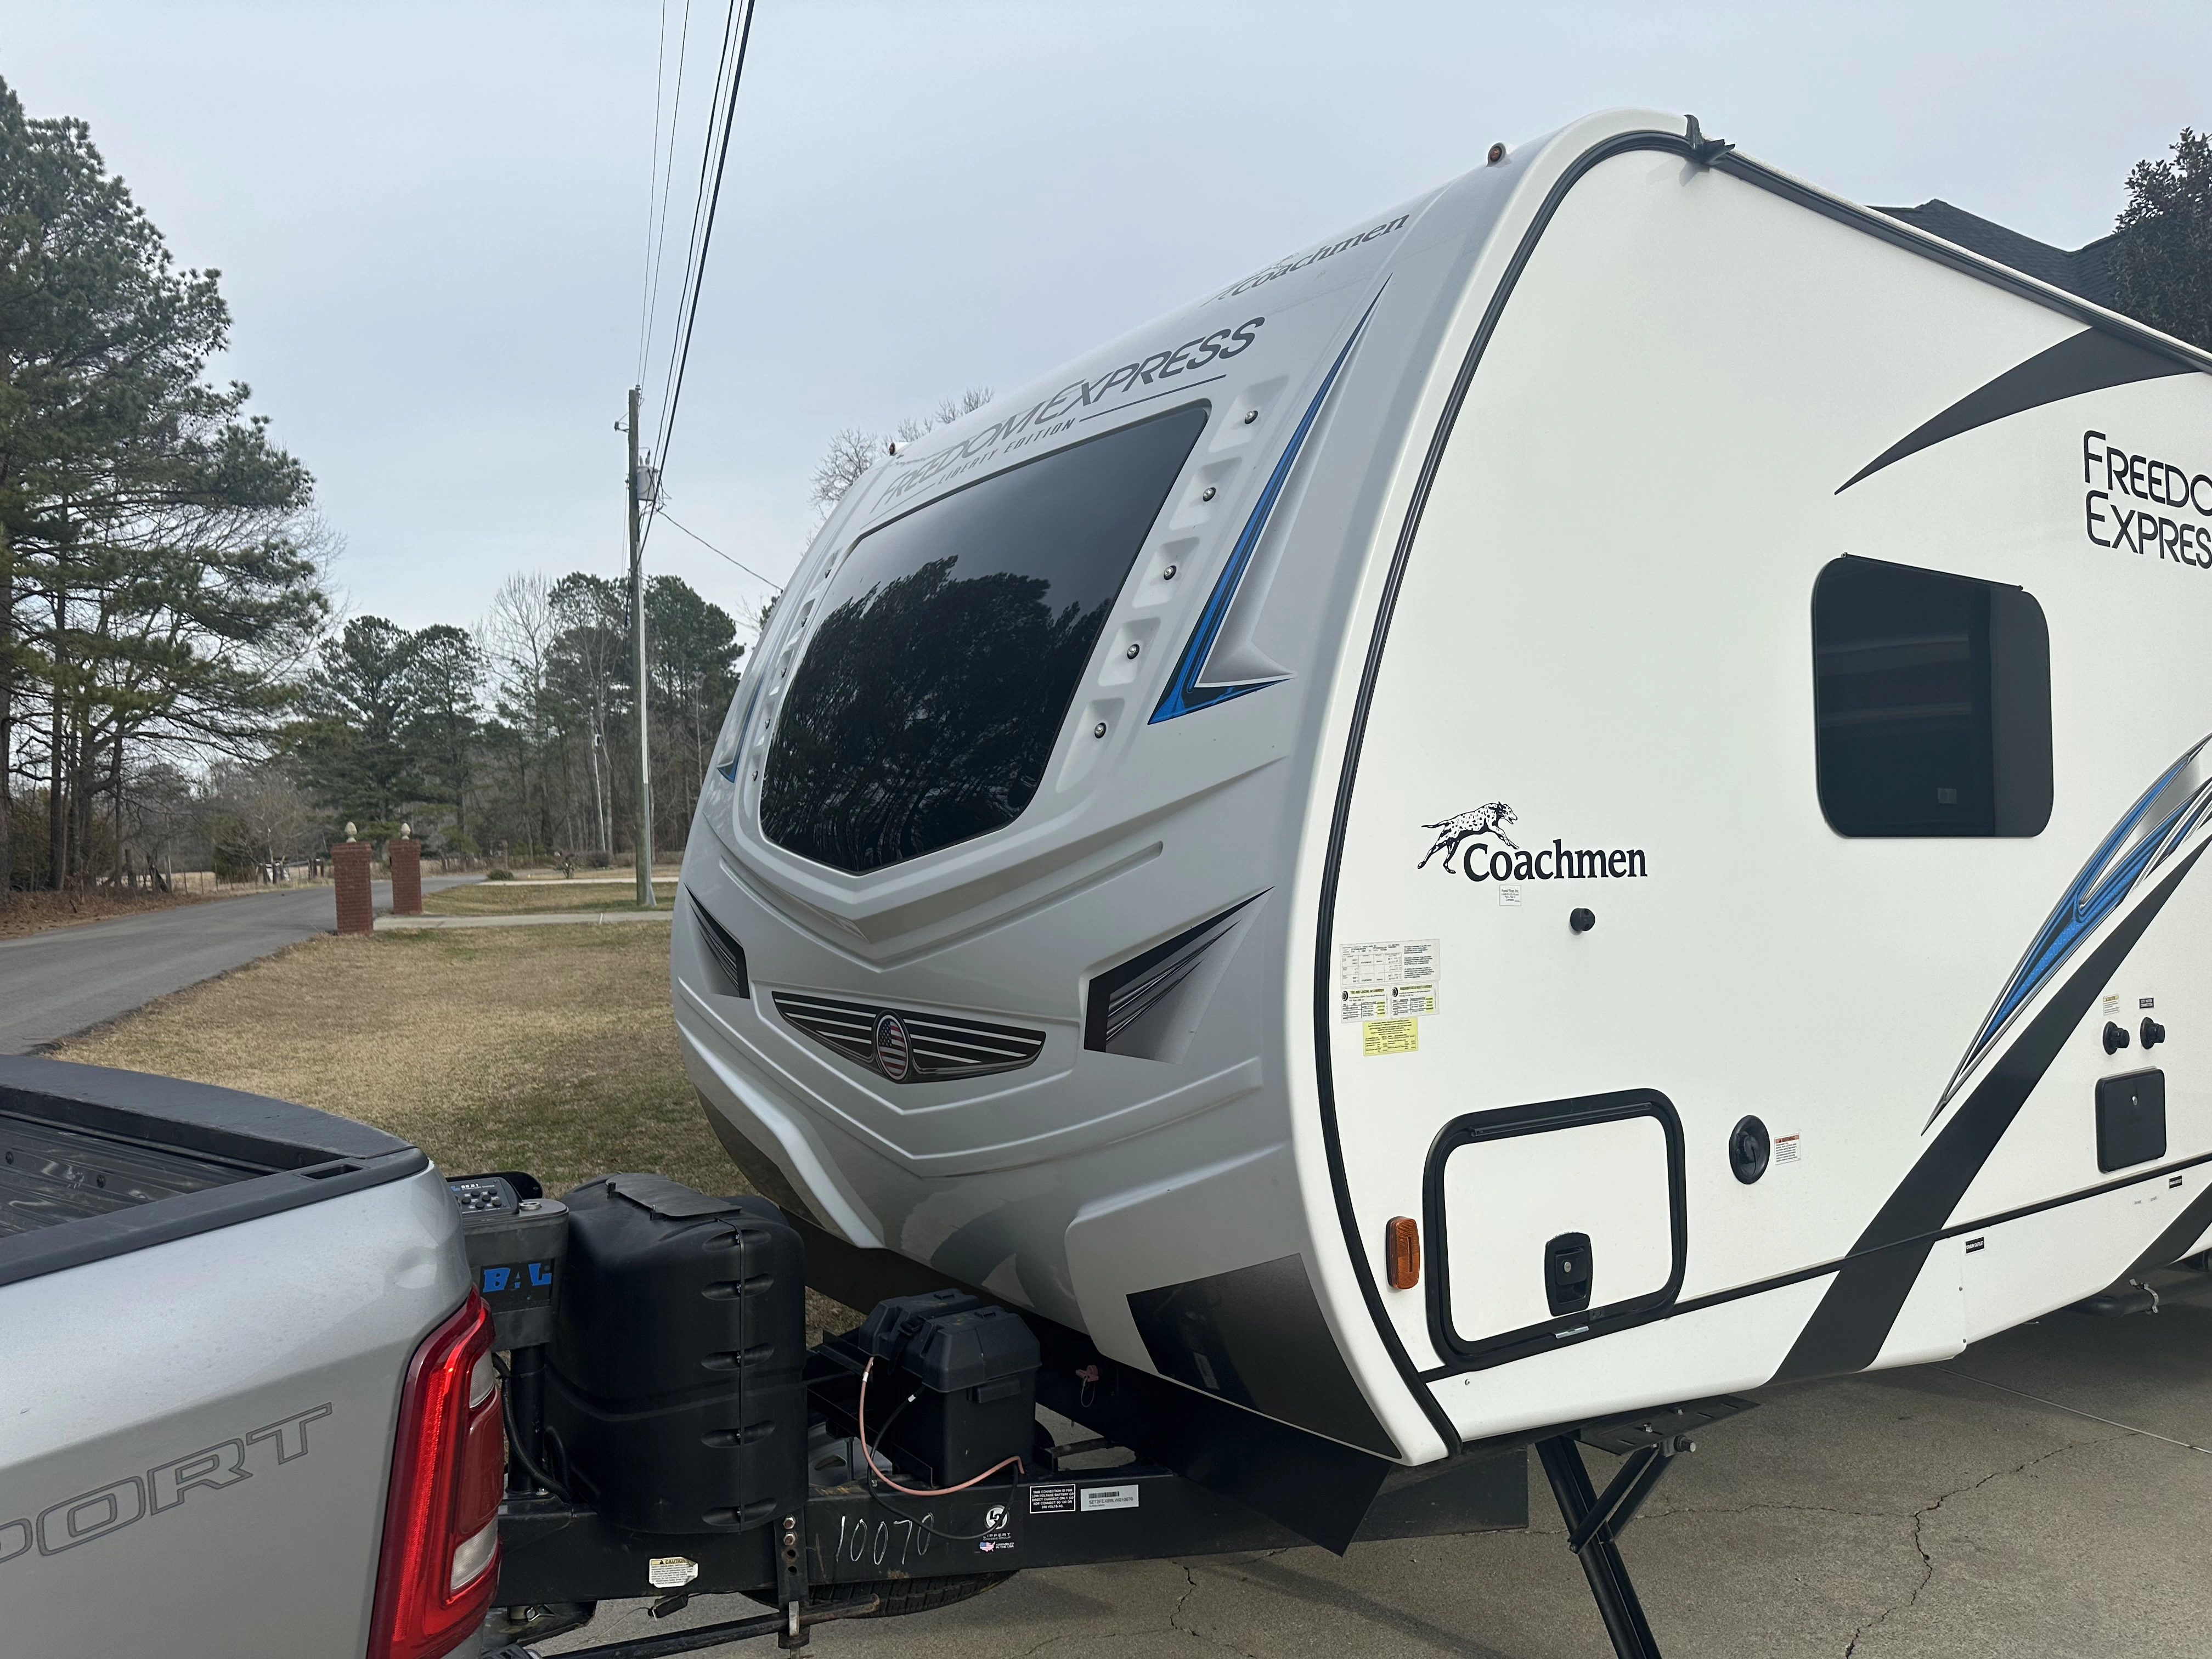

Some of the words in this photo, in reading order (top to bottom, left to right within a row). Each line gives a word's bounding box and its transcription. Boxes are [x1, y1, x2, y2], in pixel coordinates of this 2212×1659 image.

[1231, 214, 1410, 296] Coachmen
[937, 448, 999, 485] LIBERTY
[1003, 417, 1076, 454] EDITION
[1463, 838, 1648, 882] Coachmen
[836, 1512, 934, 1565] 10070
